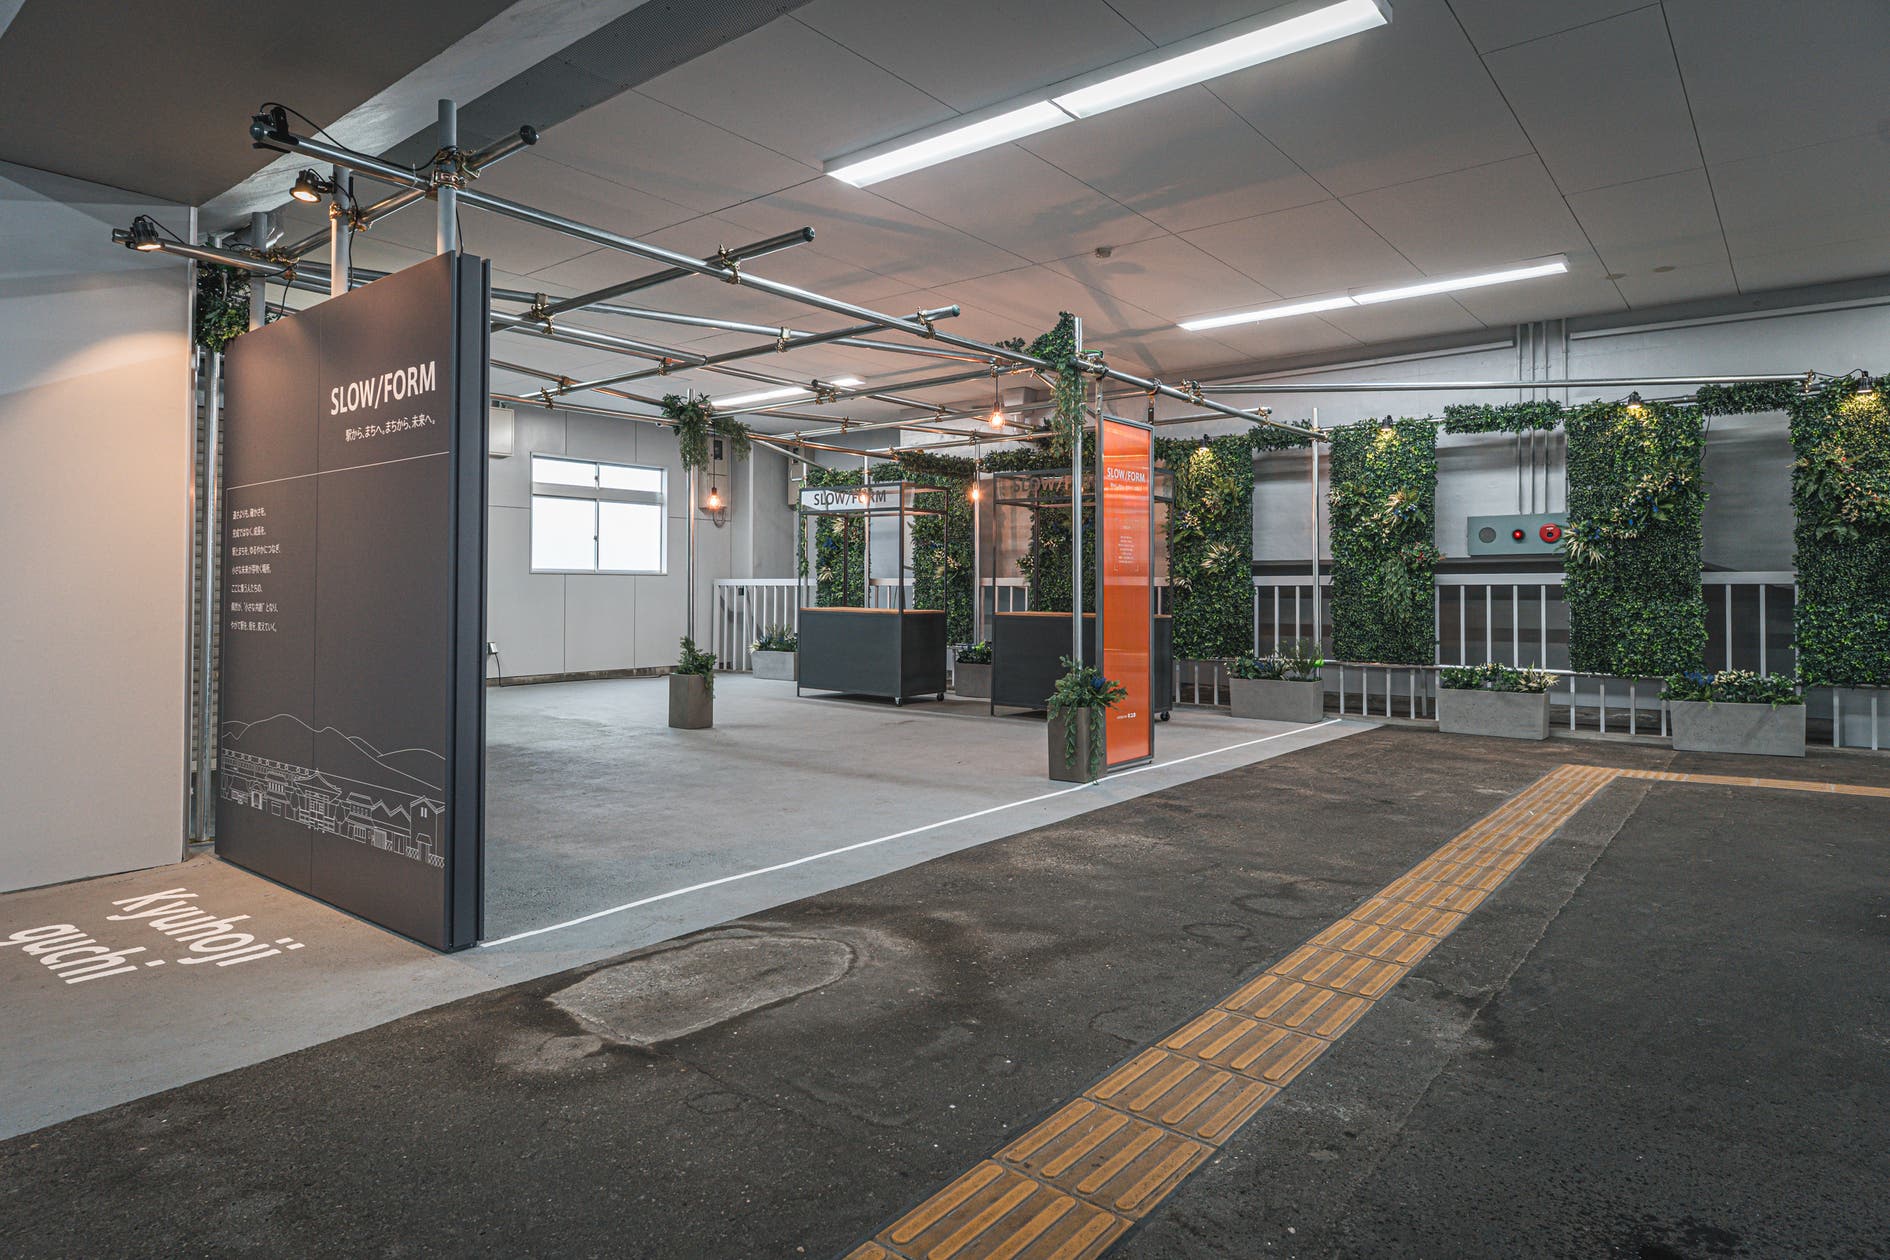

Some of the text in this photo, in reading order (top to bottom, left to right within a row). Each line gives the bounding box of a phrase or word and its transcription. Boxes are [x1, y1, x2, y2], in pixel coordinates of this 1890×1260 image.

[331, 361, 436, 416] SLOW/FORM
[345, 414, 436, 442] 駅から、まちへ。まちから、未来へ。
[1107, 467, 1145, 482] SLOW/FORM
[106, 887, 305, 967] Kyuhoji
